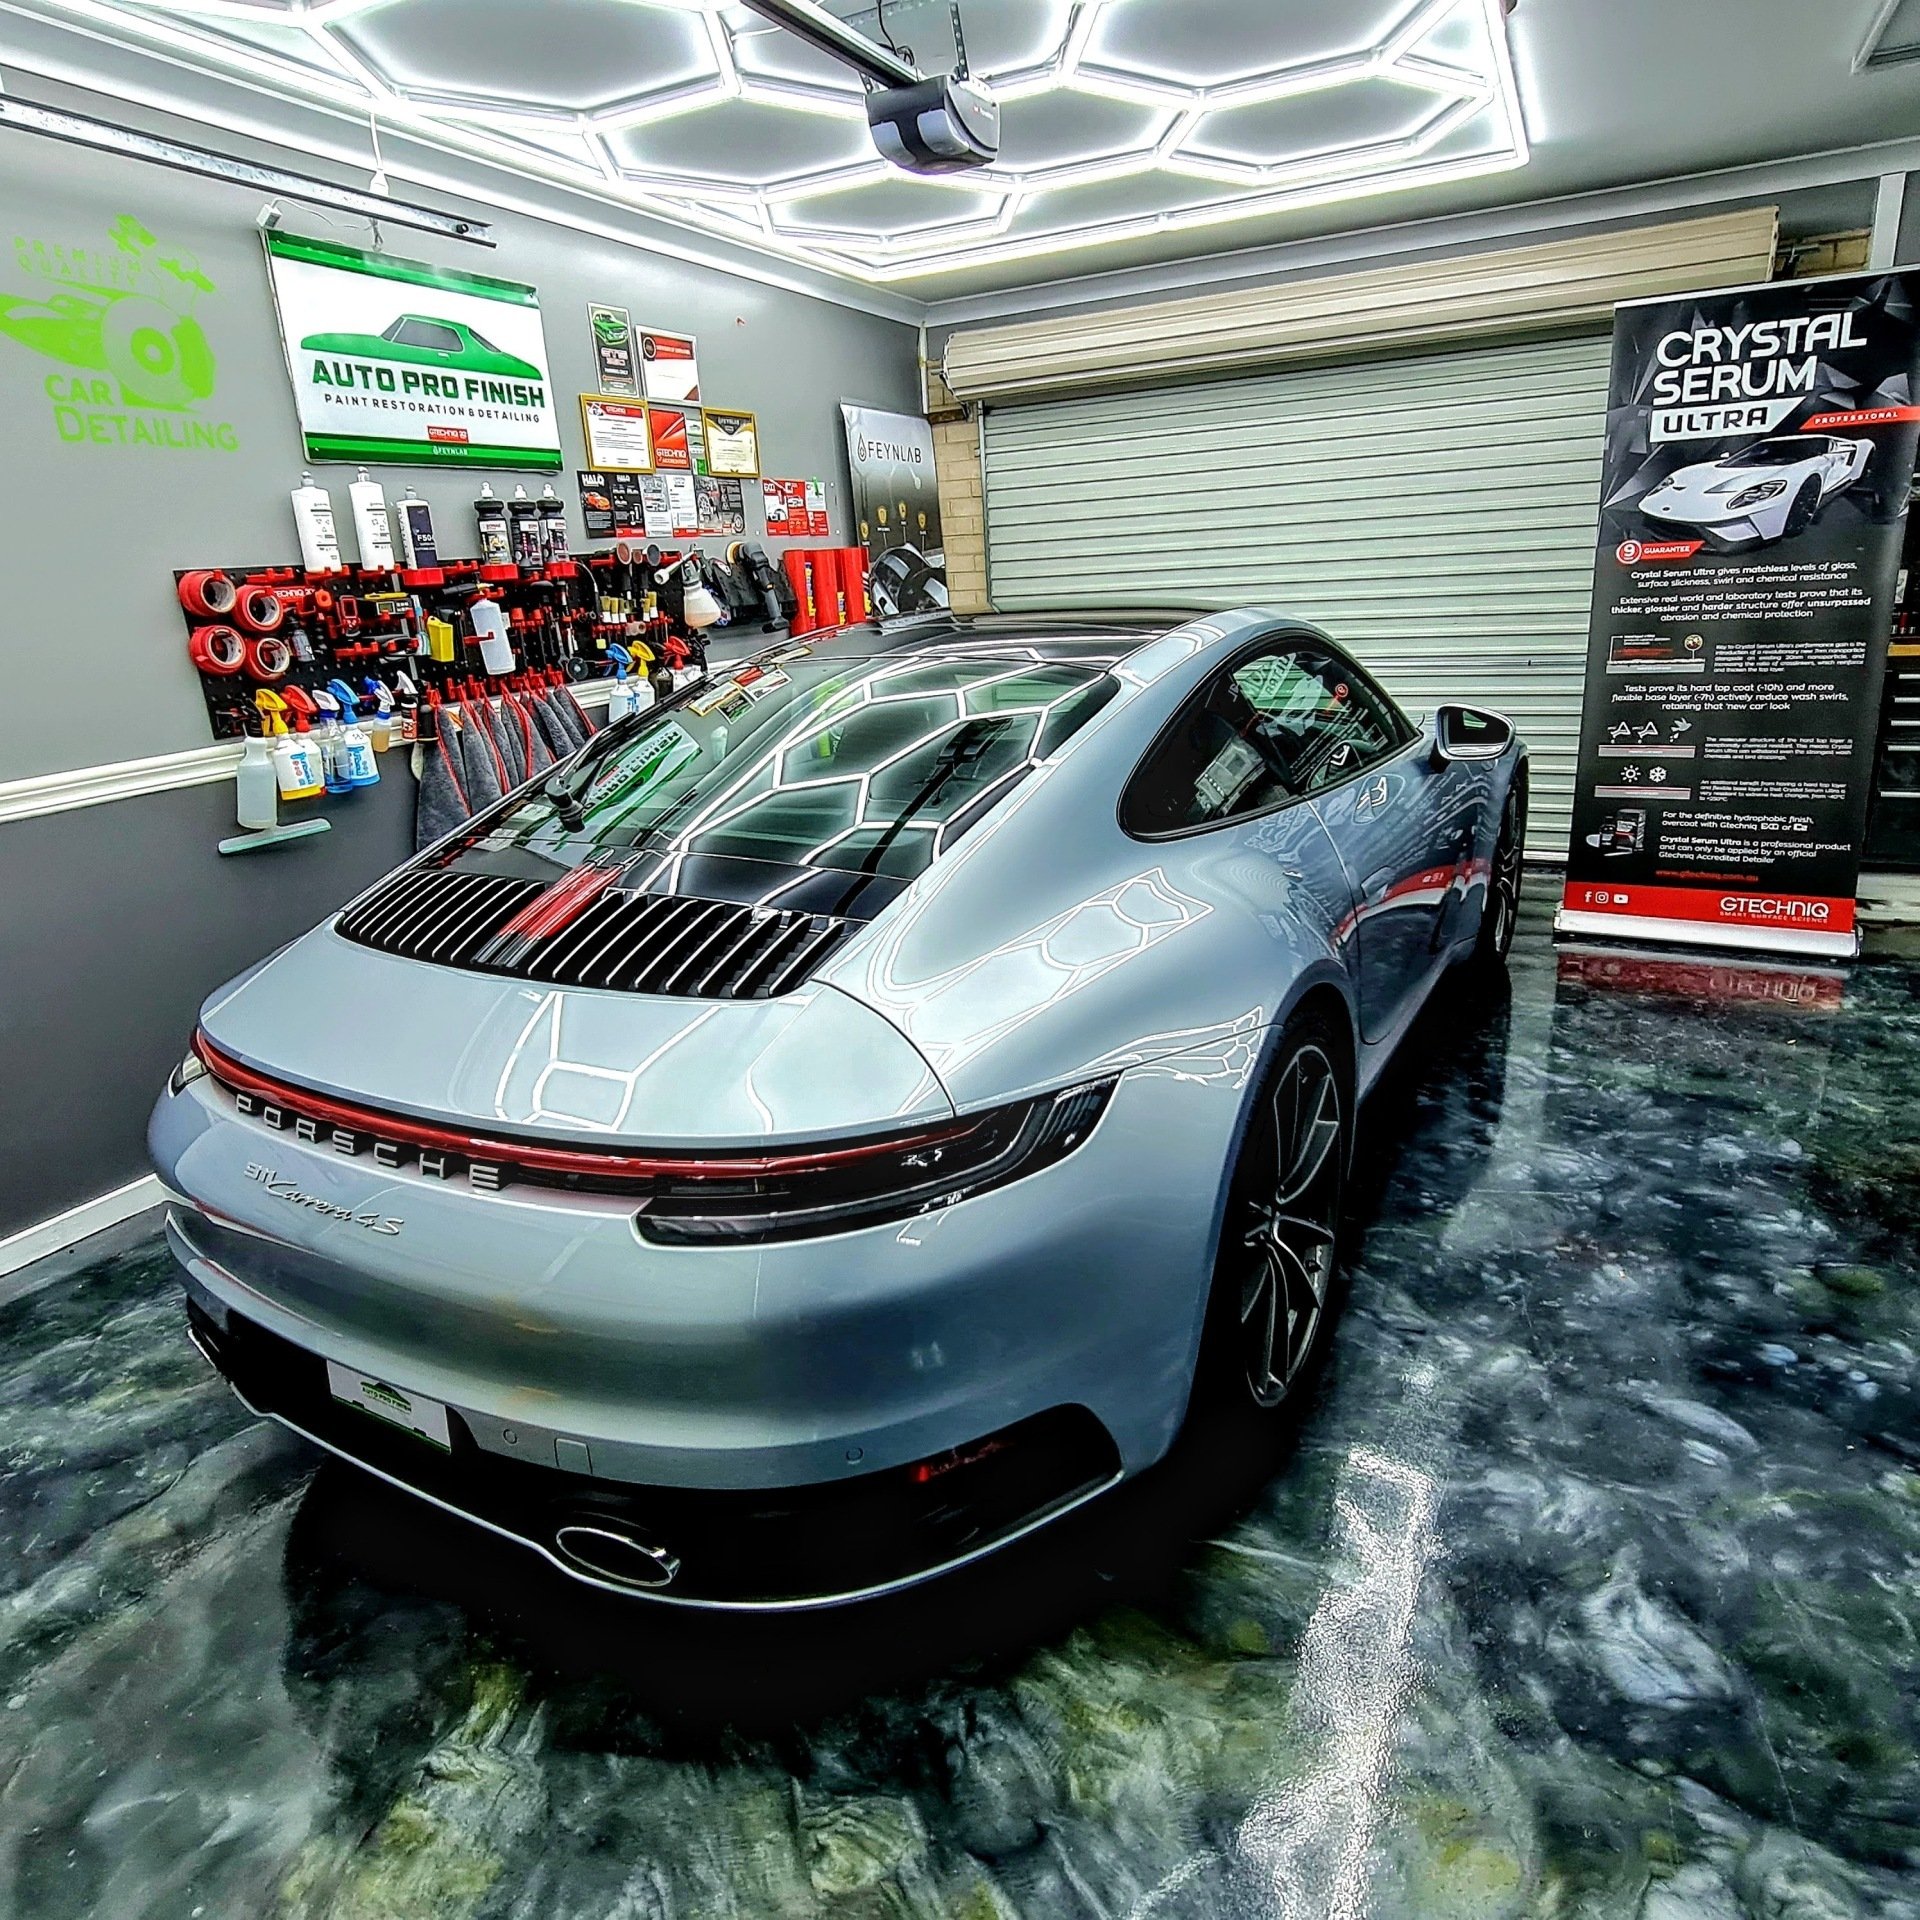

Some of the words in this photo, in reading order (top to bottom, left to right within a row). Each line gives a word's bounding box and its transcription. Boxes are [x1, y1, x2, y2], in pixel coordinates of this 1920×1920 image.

[1656, 312, 1868, 368] CRYSTAL
[313, 360, 395, 392] AUTO
[402, 370, 459, 399] PRO
[464, 378, 545, 408] FINISH
[1653, 356, 1818, 406] SERUM
[45, 374, 114, 406] CAR
[324, 394, 367, 406] PAINT
[372, 398, 464, 416] RESTORATION
[478, 409, 540, 423] DETAILING
[1664, 407, 1768, 434] ULTRA
[1814, 411, 1899, 425] PROFESSIONAL
[868, 442, 922, 463] FEYNLAB
[1644, 546, 1690, 554] GUARANTEE
[1631, 570, 1661, 580] Crystal
[1717, 567, 1740, 576] gives
[1742, 565, 1789, 573] matchless
[1818, 562, 1829, 571] of
[1831, 562, 1857, 571] gloss,
[1638, 580, 1669, 588] surface
[1714, 576, 1733, 585] swirl
[1756, 574, 1797, 582] chemical
[1620, 596, 1659, 604] Extensive
[1726, 592, 1773, 600] laboratory
[1799, 590, 1827, 598] prove
[1611, 606, 1642, 614] thicker,
[1645, 605, 1680, 614] glossier
[1781, 600, 1804, 609] offer
[1807, 598, 1871, 607] unsurpassed
[1721, 611, 1762, 619] chemical
[1765, 610, 1813, 619] protection
[1714, 683, 1730, 692] top
[1733, 683, 1754, 692] coat
[1611, 694, 1643, 703] flexible
[1717, 693, 1752, 702] actively
[1819, 693, 1849, 701] swirls,
[1720, 822, 1757, 830] Gtechniq
[1788, 816, 1814, 824] finish,
[1761, 840, 1813, 849] professional
[1659, 852, 1694, 860] Gtechniq
[1788, 850, 1817, 859] official
[1720, 897, 1829, 918] GTECHNIQ
[236, 1094, 500, 1190] PORSCHE
[244, 1162, 277, 1183] 911
[266, 1181, 352, 1220] Carrera
